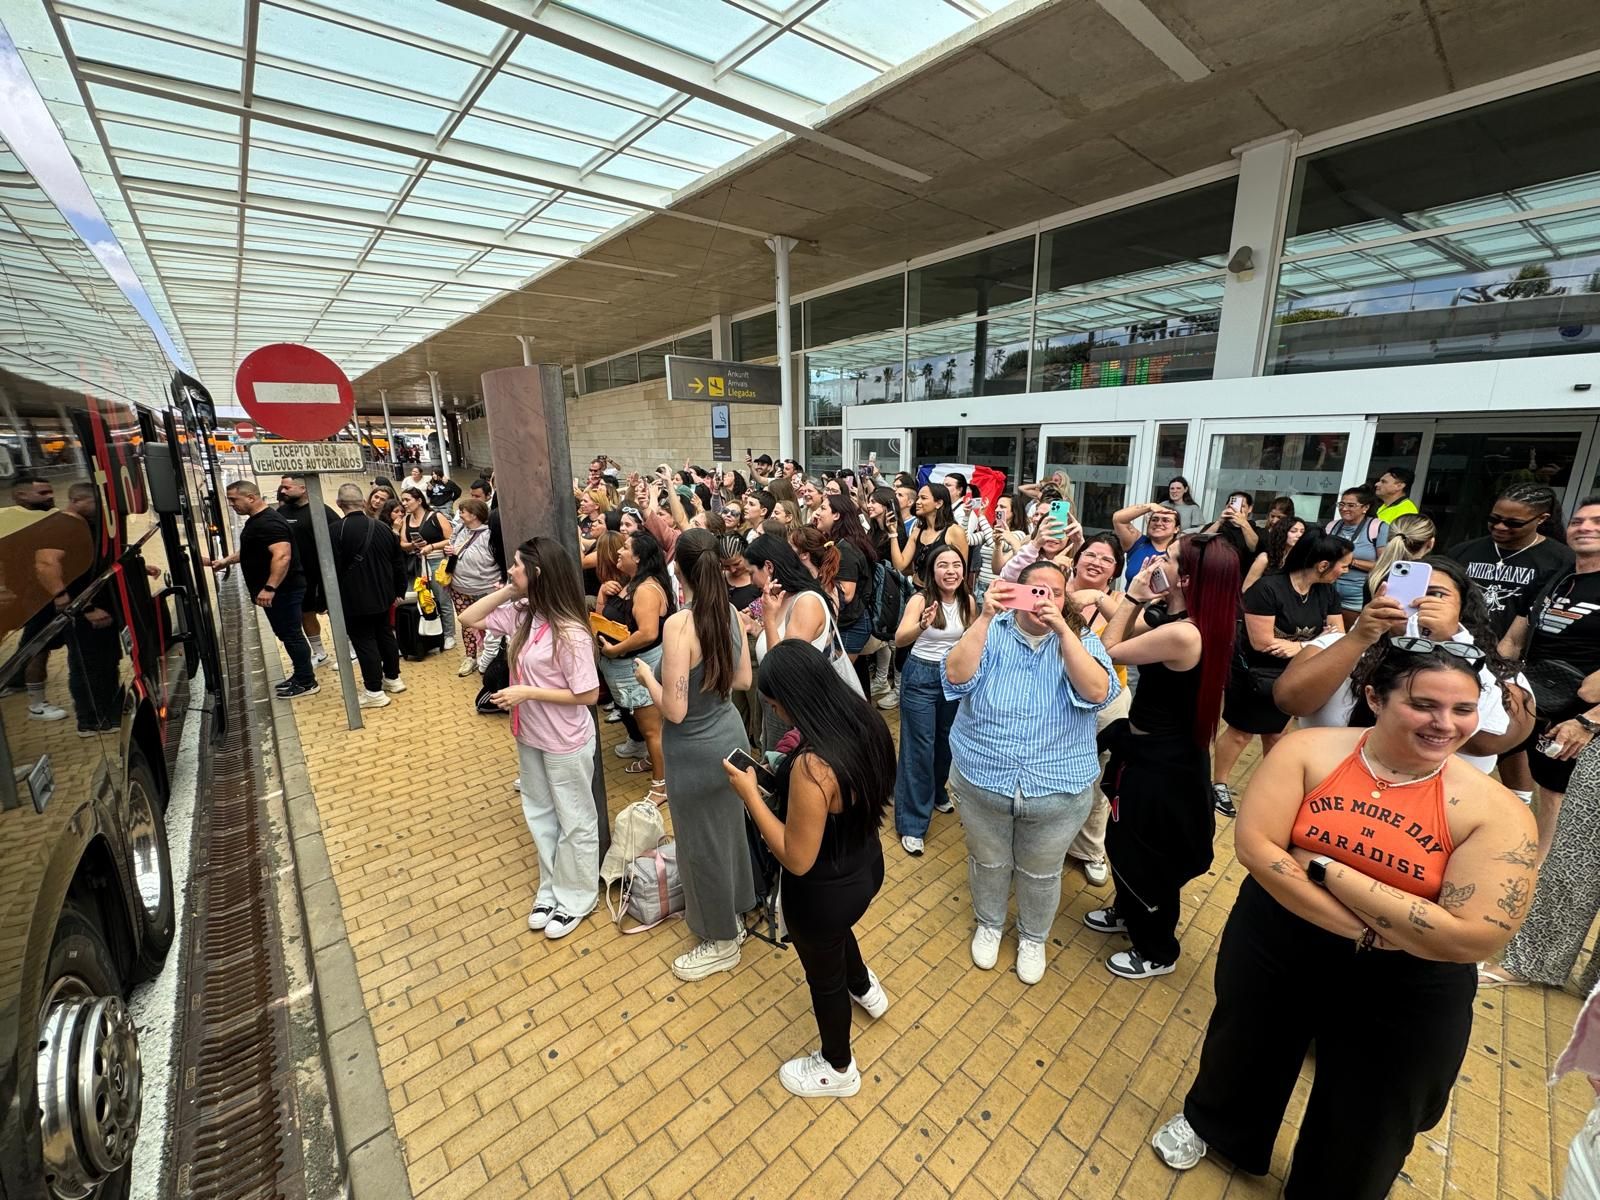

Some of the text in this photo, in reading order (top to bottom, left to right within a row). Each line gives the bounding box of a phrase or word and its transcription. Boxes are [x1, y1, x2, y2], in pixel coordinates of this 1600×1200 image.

[727, 370, 749, 378] Ankunft
[727, 388, 756, 398] Llegadas
[272, 445, 311, 457] EXCEPTO
[313, 445, 330, 457] BUS
[255, 458, 361, 471] VEHICULOS AUTORIZADOS
[1465, 562, 1535, 585] NIRVANA
[1309, 796, 1444, 855] ONE MORE DAY
[1360, 826, 1375, 839] IN
[1305, 825, 1425, 882] PARADISE
